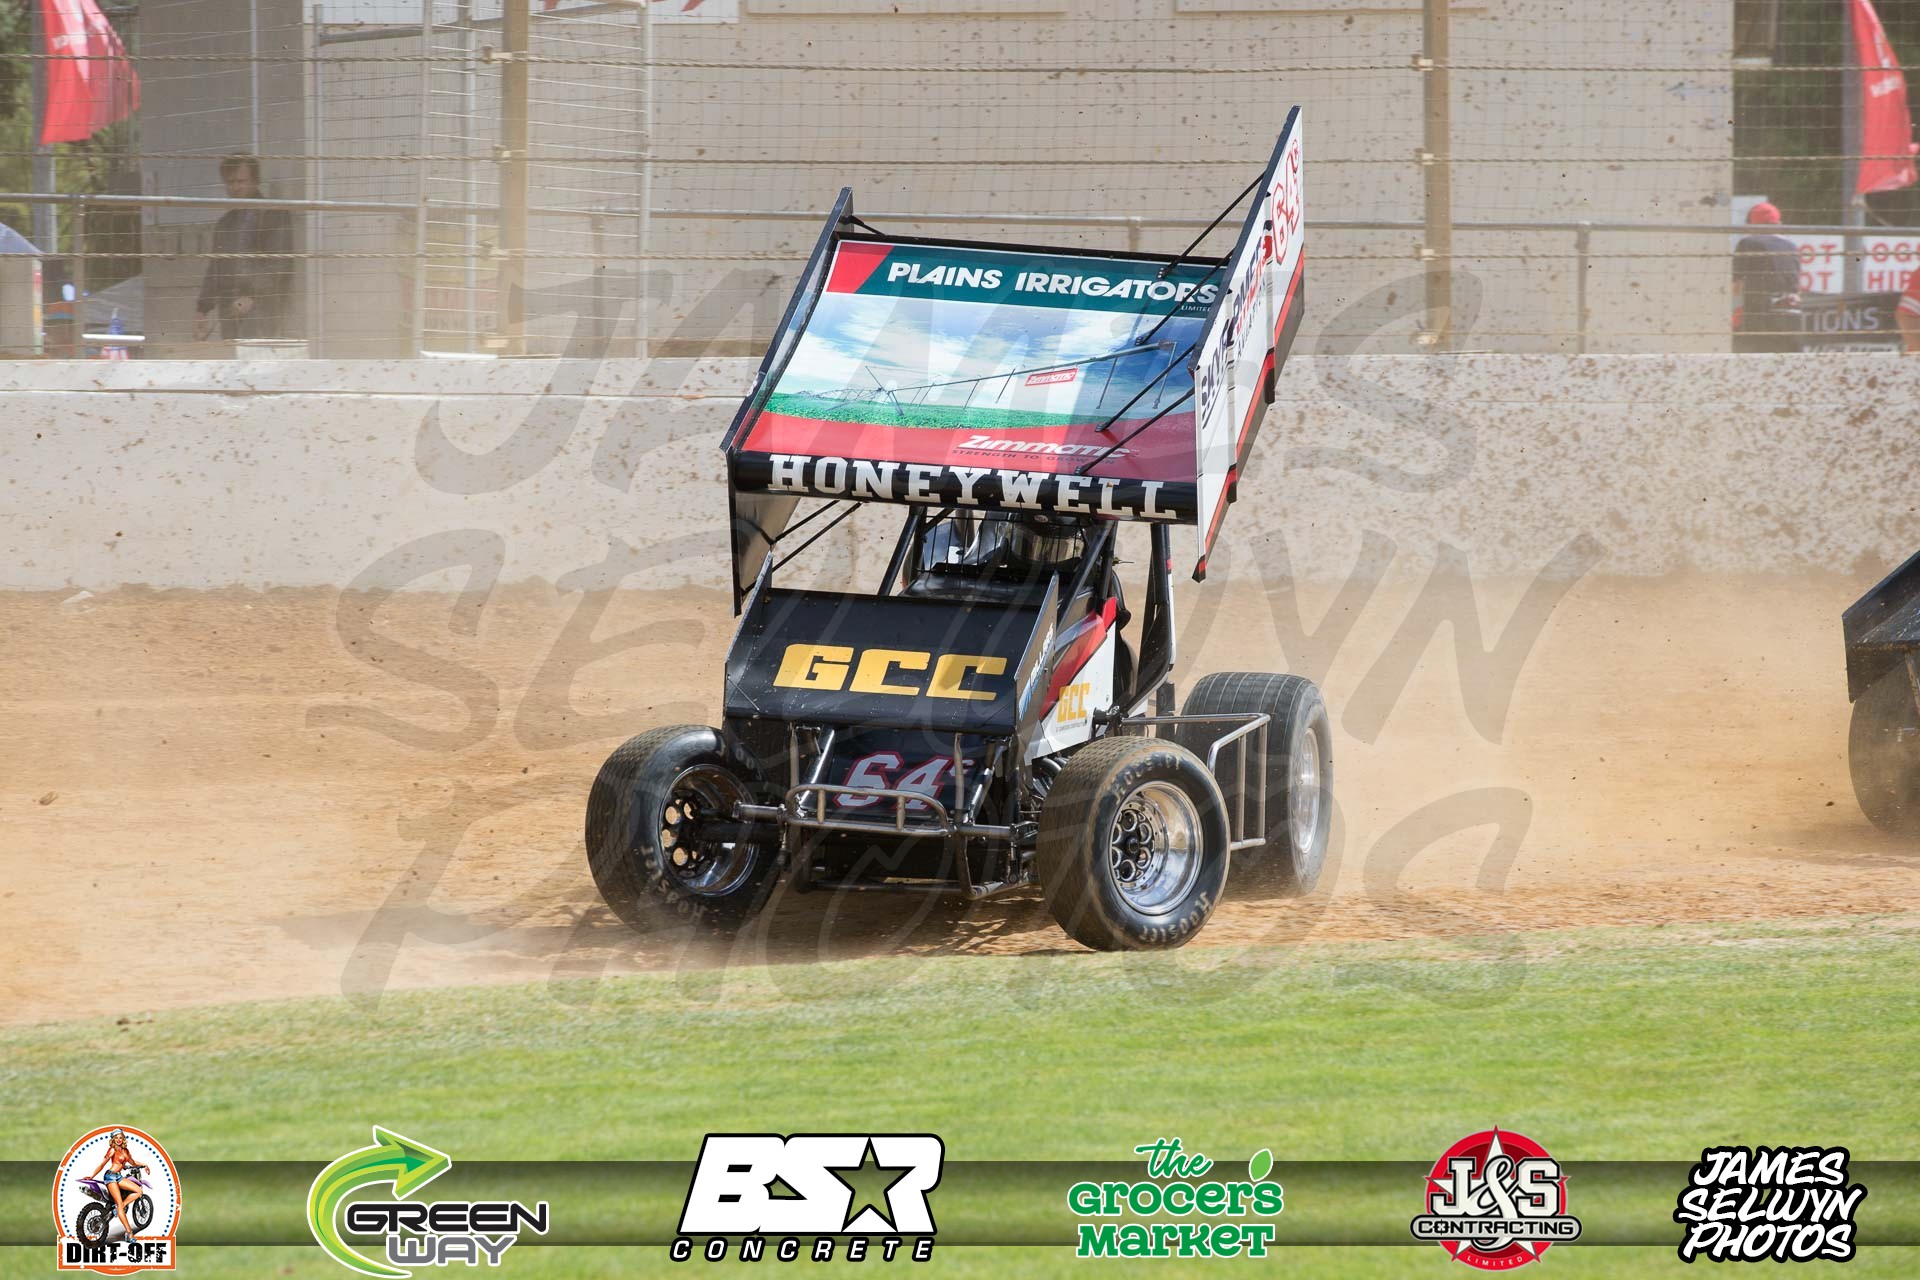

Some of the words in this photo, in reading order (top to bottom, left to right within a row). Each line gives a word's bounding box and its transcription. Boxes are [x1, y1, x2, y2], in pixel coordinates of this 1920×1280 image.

[1797, 244, 1837, 264] OT
[1862, 242, 1920, 263] OG
[887, 262, 1002, 289] PLAINS
[1014, 271, 1219, 304] IRRIGATORS
[1797, 271, 1834, 291] OT
[1867, 271, 1913, 291] HIP
[951, 450, 1018, 459] STRENGTH
[767, 454, 1177, 520] HONEYWELL
[773, 643, 1007, 701] GCC
[1056, 682, 1091, 723] GCC
